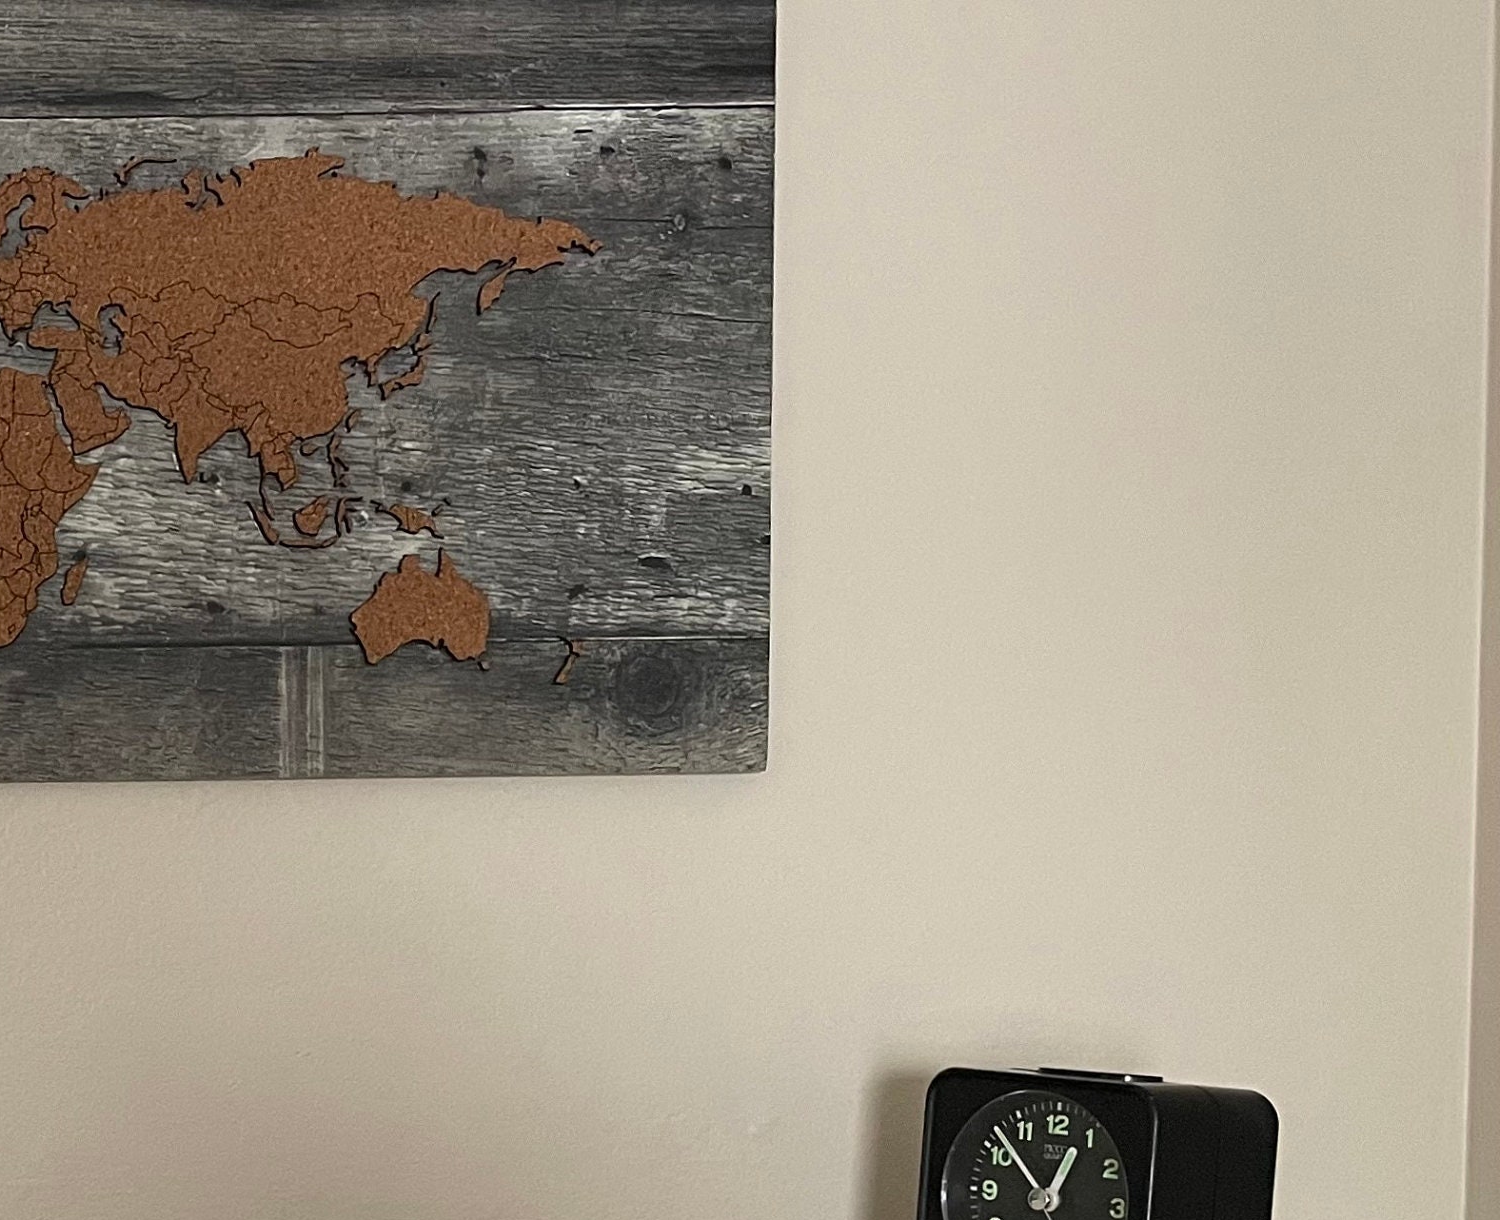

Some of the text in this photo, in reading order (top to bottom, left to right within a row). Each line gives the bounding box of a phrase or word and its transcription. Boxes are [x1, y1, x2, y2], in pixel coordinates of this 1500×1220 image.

[1017, 1122, 1033, 1141] 11
[1047, 1115, 1069, 1136] 12
[1085, 1128, 1093, 1148] 1
[991, 1147, 1013, 1167] 10
[1103, 1159, 1119, 1179] 2
[982, 1180, 998, 1200] 9
[1109, 1198, 1125, 1218] 3
